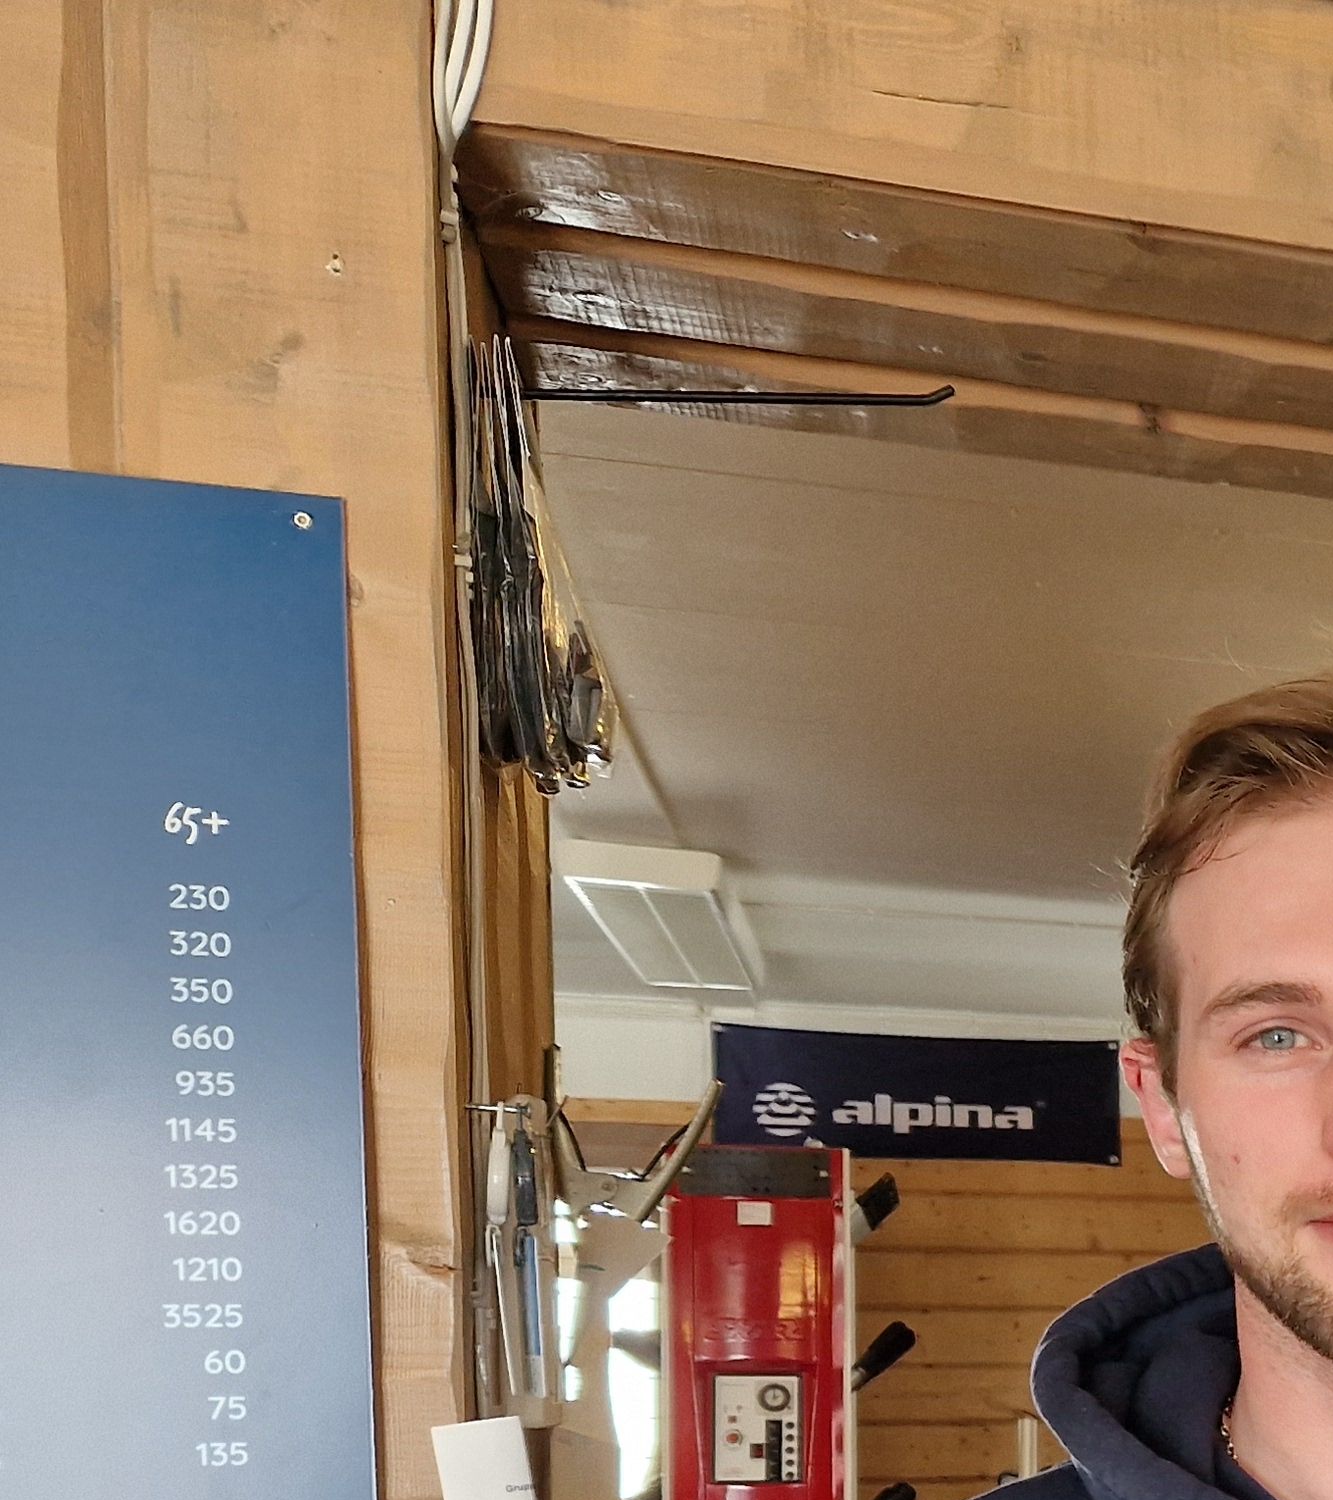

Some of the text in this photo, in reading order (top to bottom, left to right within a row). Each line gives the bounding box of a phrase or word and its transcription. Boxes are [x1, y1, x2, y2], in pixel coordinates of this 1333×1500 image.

[164, 801, 229, 844] 65+
[169, 883, 230, 911] 230
[169, 931, 232, 957] 320
[170, 977, 233, 1003] 350
[172, 1024, 234, 1050] 660
[175, 1071, 235, 1096] 935
[832, 1093, 1033, 1134] alpina
[165, 1118, 237, 1142] 1145
[165, 1164, 238, 1189] 1325
[164, 1211, 240, 1235] 1620
[172, 1257, 242, 1281] 1210
[162, 1304, 243, 1328] 3525
[204, 1350, 246, 1374] 60
[208, 1396, 247, 1420] 75
[196, 1442, 248, 1467] 135
